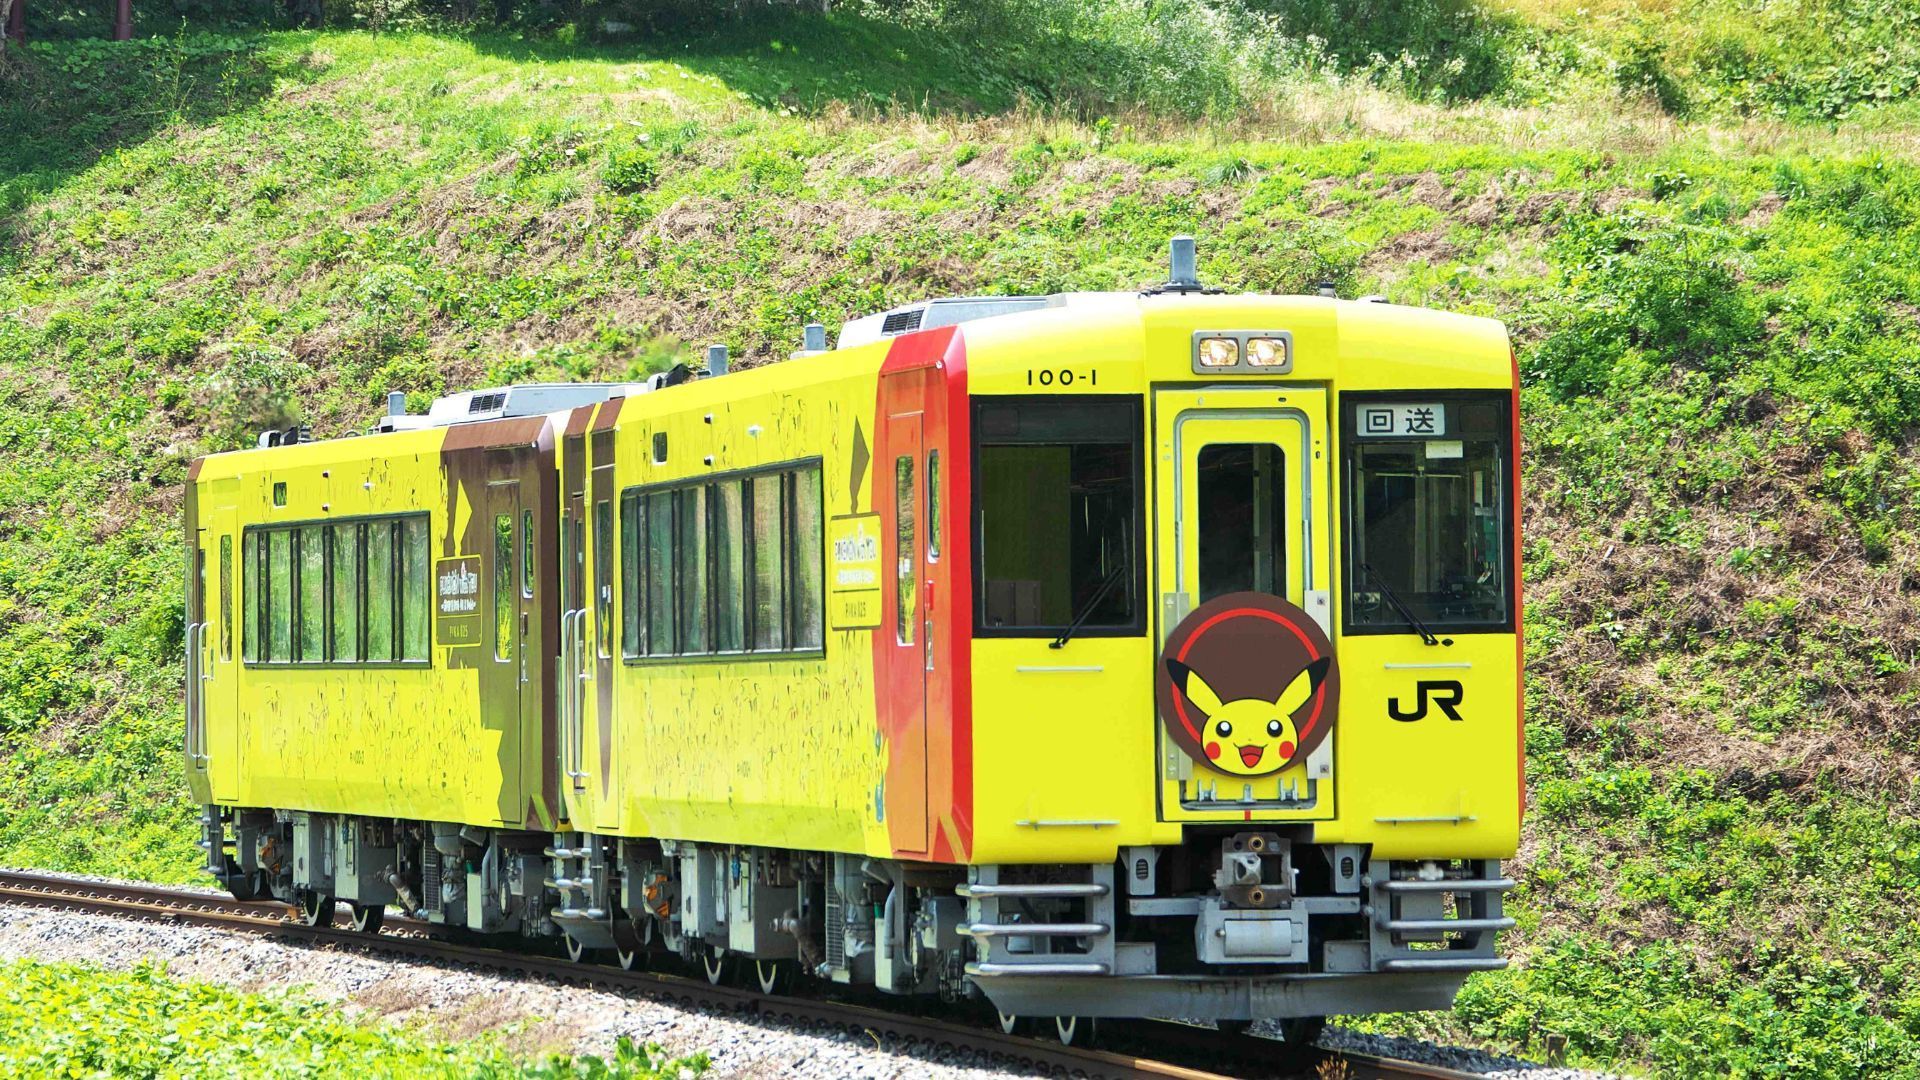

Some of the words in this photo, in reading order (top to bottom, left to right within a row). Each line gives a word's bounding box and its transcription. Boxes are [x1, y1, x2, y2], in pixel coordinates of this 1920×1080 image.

[1028, 369, 1096, 386] 100-1
[1366, 407, 1434, 433] 回送
[1388, 680, 1464, 722] JR
